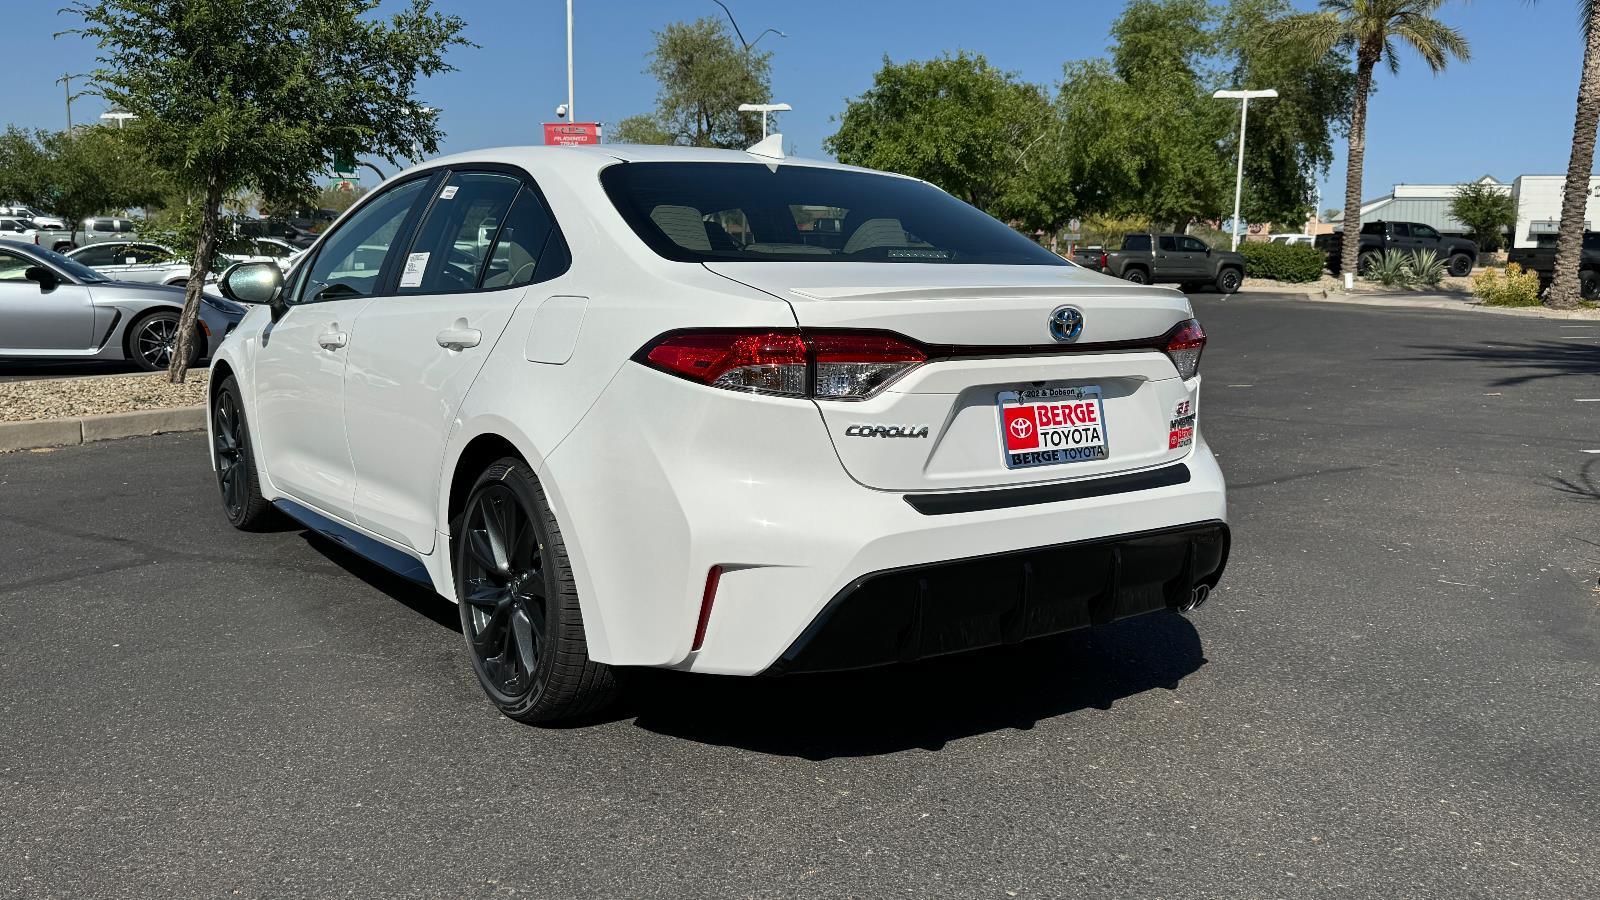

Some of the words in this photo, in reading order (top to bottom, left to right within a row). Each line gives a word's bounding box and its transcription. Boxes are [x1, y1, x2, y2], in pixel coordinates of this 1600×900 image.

[1037, 403, 1097, 427] BERGE
[845, 425, 929, 438] COROLLA
[1041, 427, 1101, 447] TOYOTA
[1011, 449, 1060, 465] BERGE
[1060, 445, 1105, 459] TOYOTA
